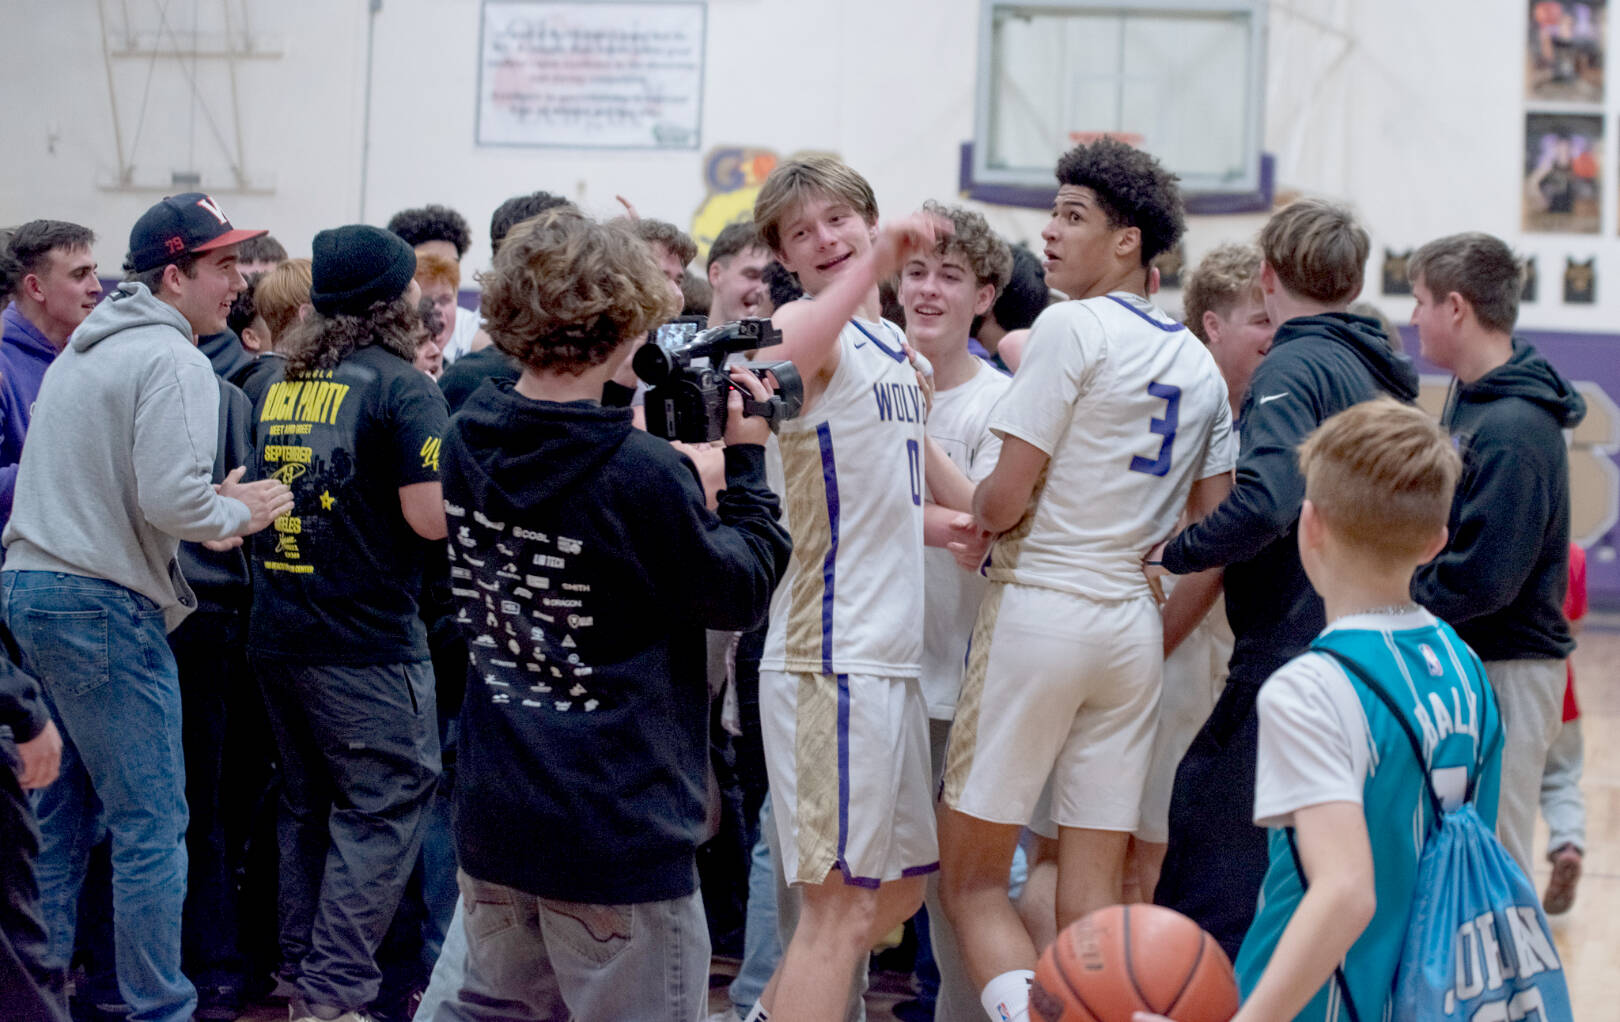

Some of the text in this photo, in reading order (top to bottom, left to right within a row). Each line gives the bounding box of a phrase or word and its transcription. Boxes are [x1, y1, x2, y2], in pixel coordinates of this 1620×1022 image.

[295, 381, 350, 425] PARTY
[873, 382, 926, 425] WOLV
[1128, 381, 1182, 477] 3
[264, 445, 312, 463] SEPTEMBER
[906, 439, 921, 506] 0
[561, 582, 590, 592] SMITH
